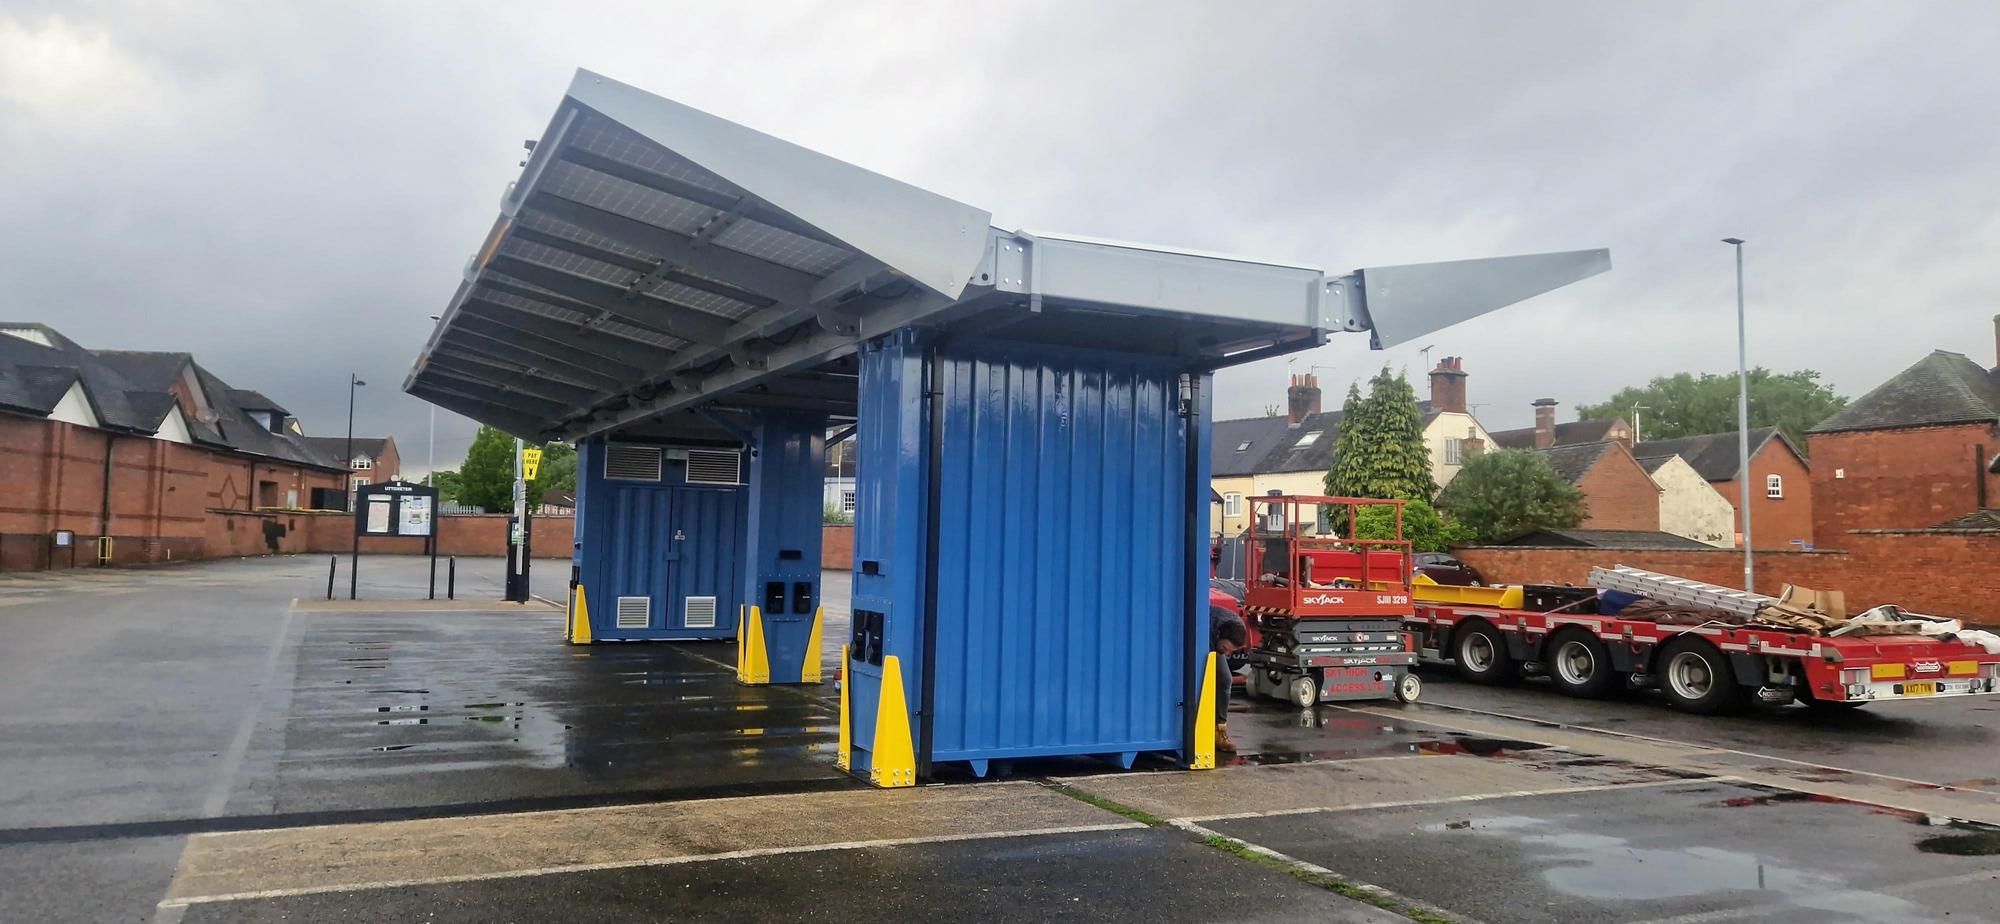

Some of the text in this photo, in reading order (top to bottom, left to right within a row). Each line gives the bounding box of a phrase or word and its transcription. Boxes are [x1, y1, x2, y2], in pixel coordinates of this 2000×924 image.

[1303, 594, 1344, 605] SKYJACK
[1392, 595, 1408, 604] 3219
[1312, 634, 1338, 642] SKYJACK
[1343, 657, 1377, 665] SKYJACK
